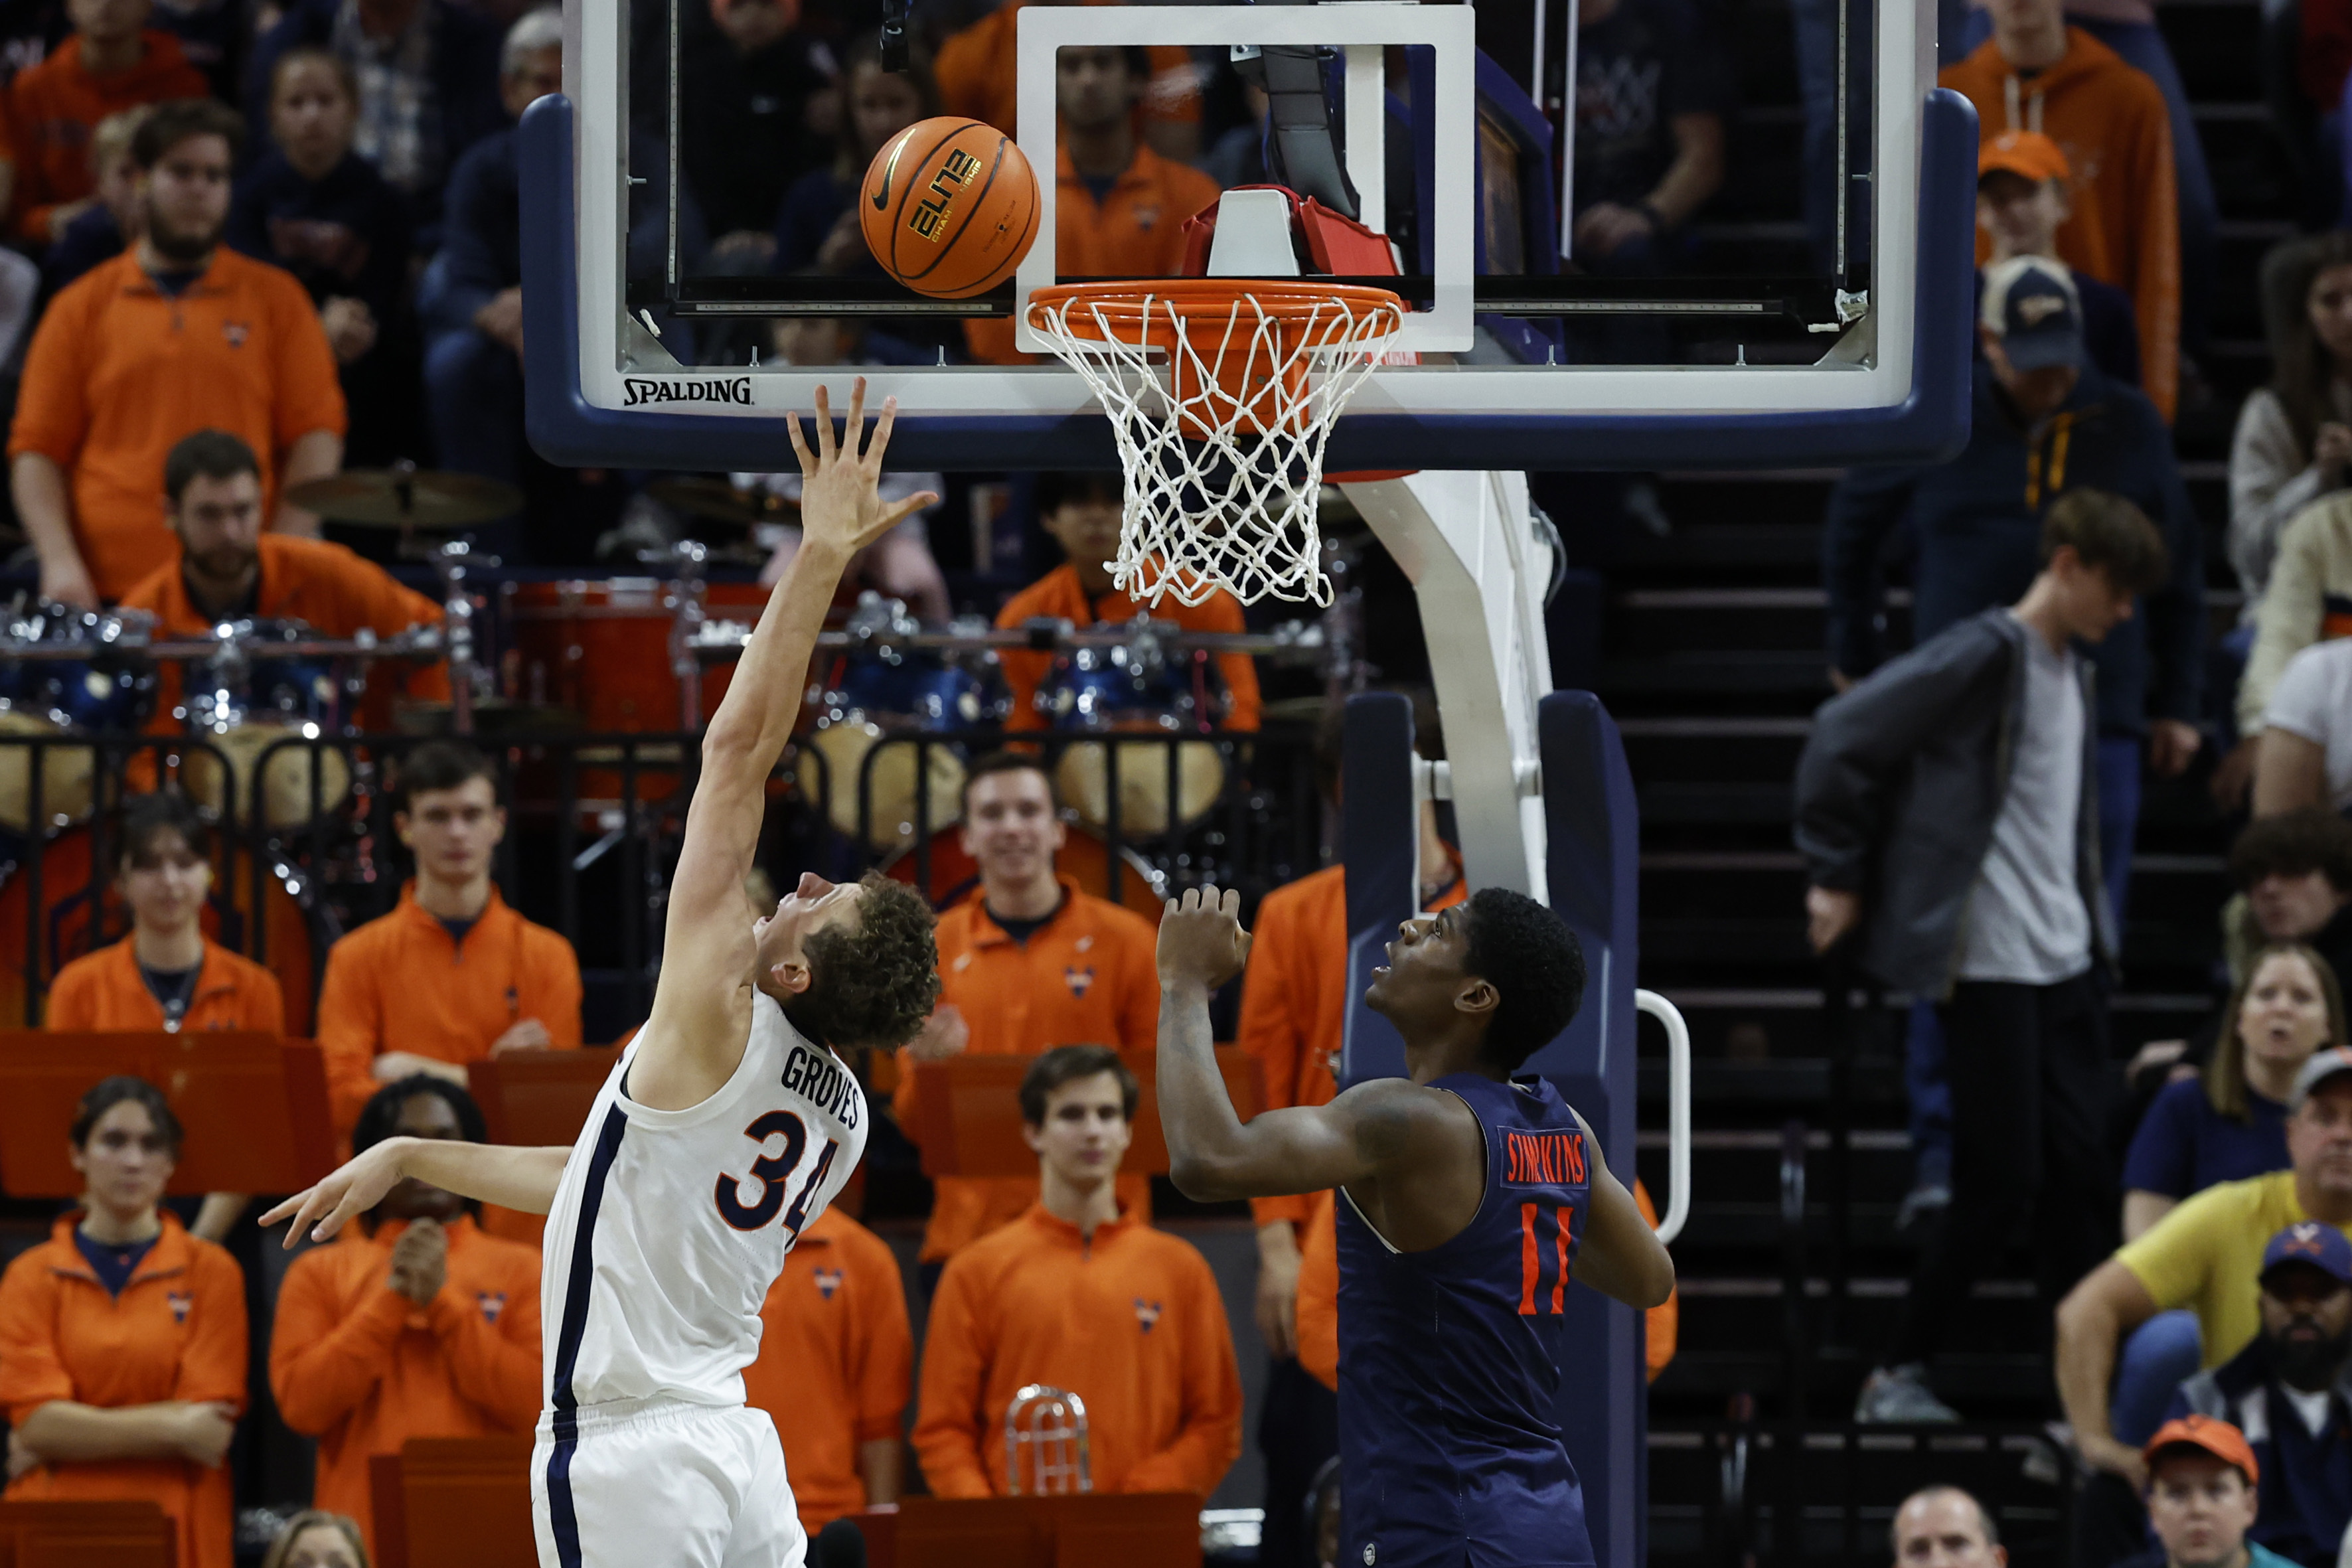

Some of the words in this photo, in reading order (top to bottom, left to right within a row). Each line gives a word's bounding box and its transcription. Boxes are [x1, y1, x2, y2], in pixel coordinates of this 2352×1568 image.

[907, 147, 976, 239] ELITE
[931, 160, 982, 243] CHAMNSHIP
[624, 376, 751, 406] SPALDING
[781, 1046, 858, 1130] GROVES
[1518, 1203, 1574, 1315] 11
